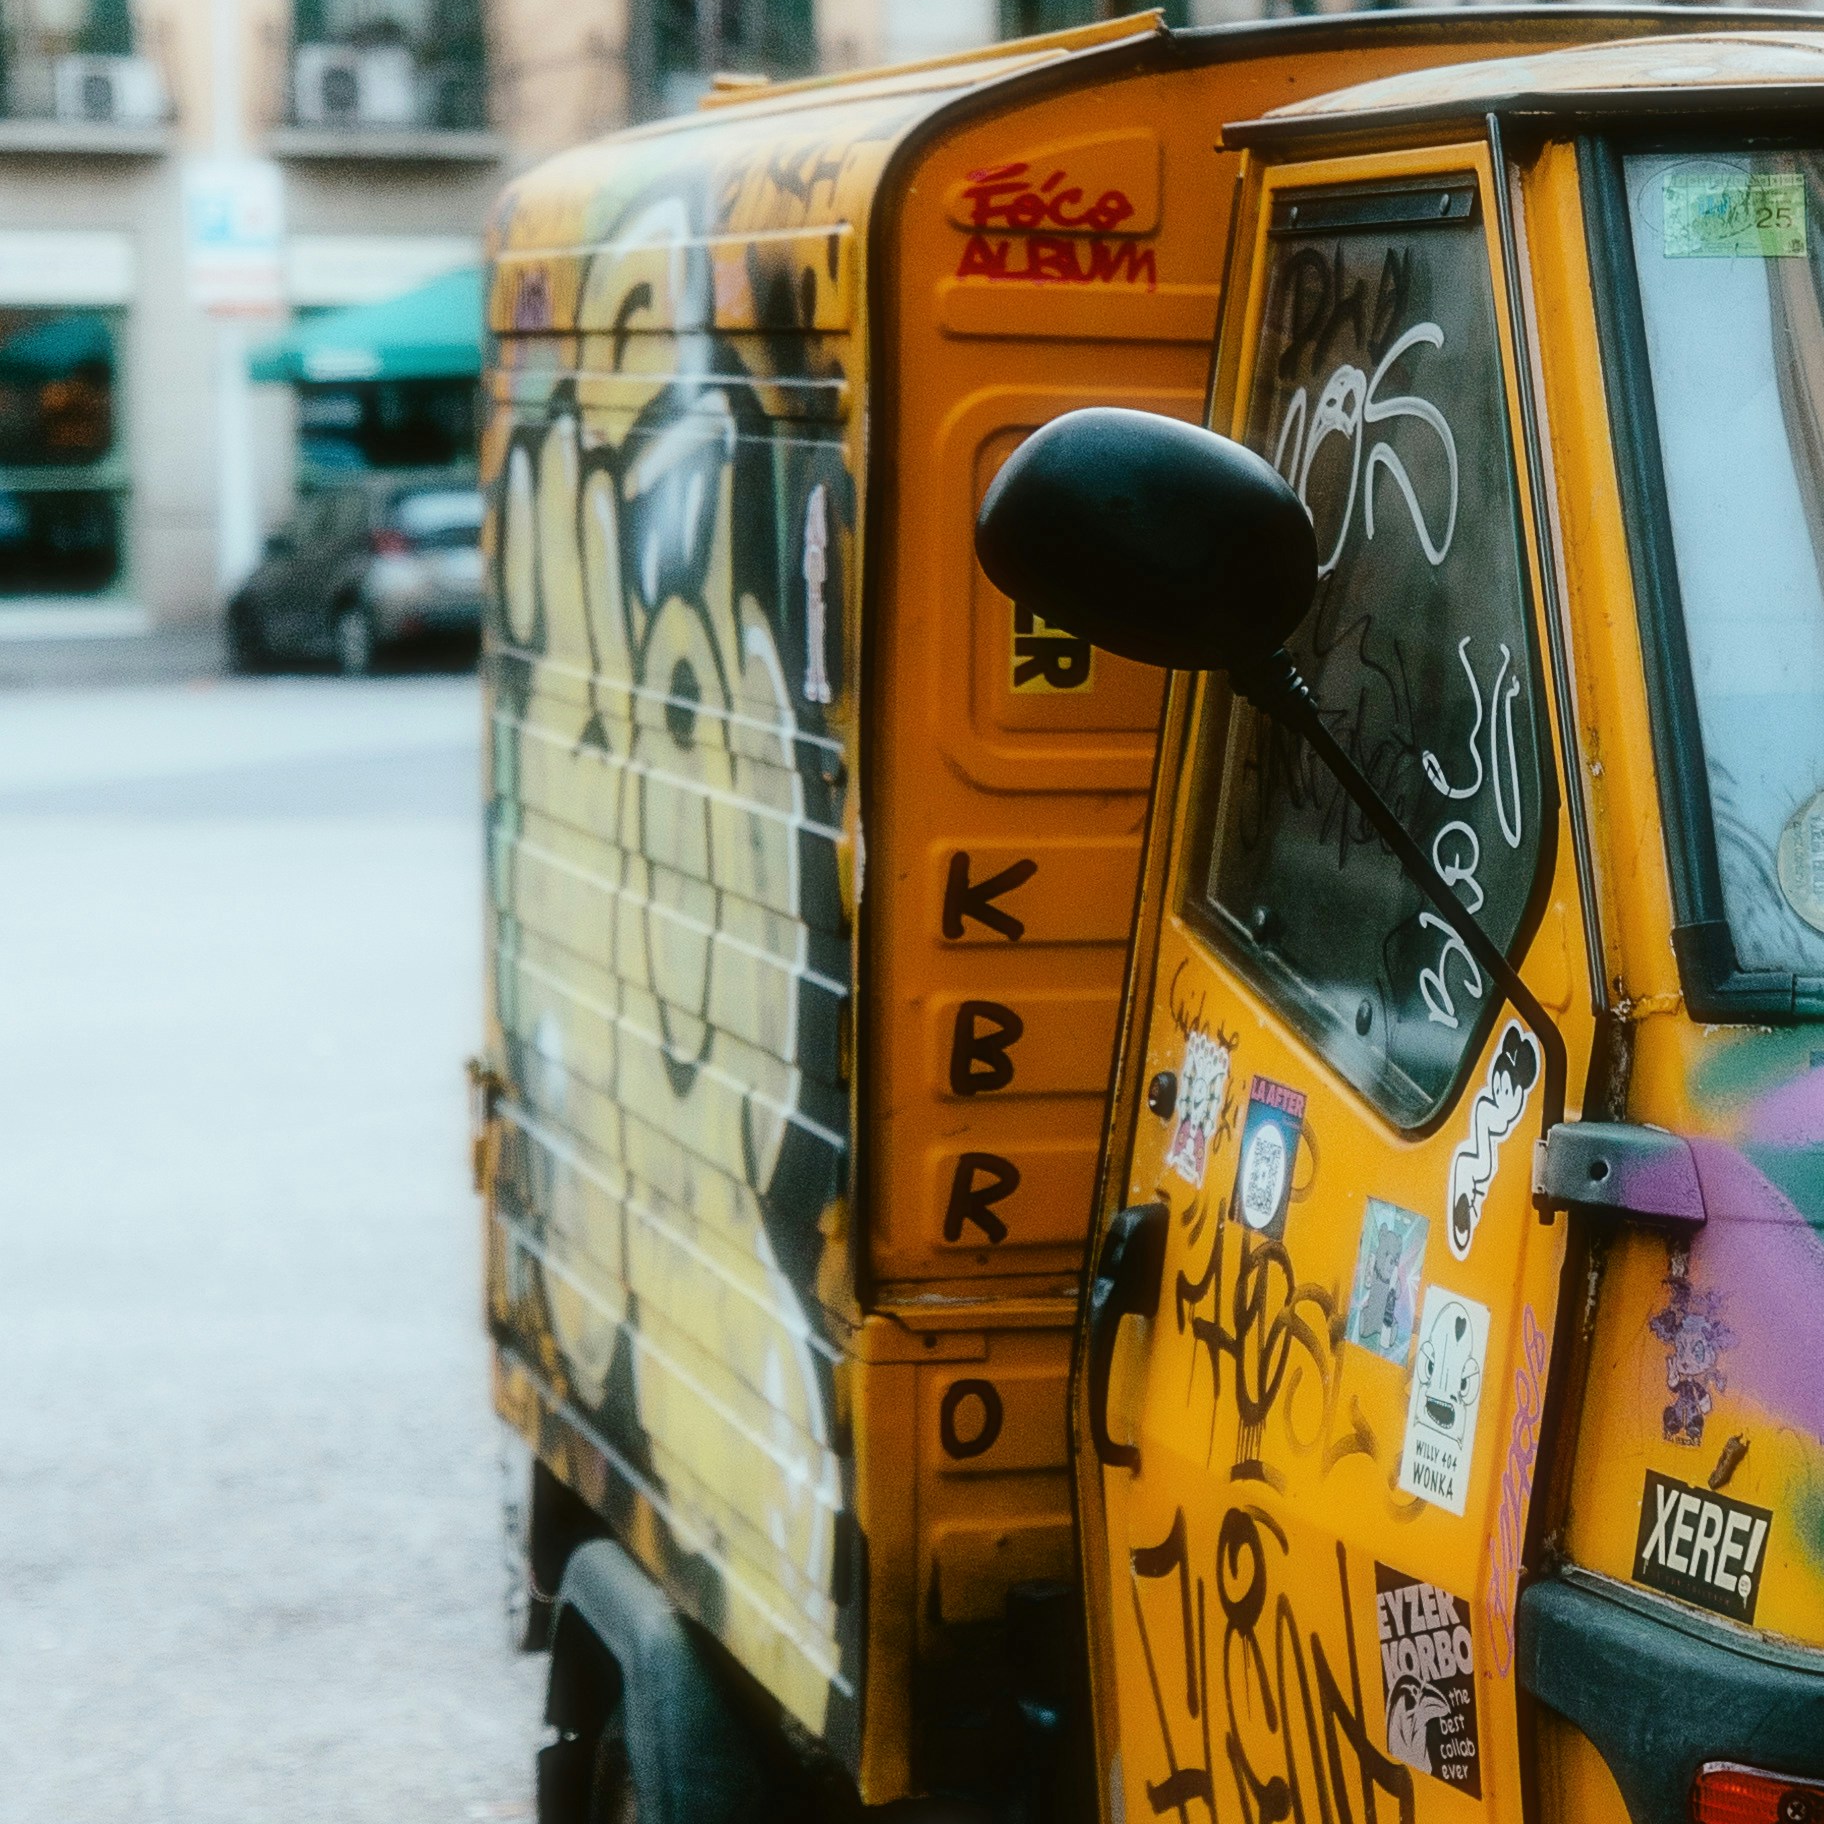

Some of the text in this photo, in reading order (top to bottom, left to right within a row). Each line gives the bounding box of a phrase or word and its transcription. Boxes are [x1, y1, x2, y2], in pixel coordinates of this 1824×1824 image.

[1755, 207, 1793, 229] 25
[1415, 1439, 1458, 1472] WILLY 404
[1412, 1461, 1454, 1501] WONKA
[1641, 1483, 1769, 1599] XERE!
[1380, 1625, 1474, 1689] KORBO
[1448, 1687, 1472, 1707] the
[1439, 1713, 1466, 1736] best
[1440, 1738, 1476, 1758] collab
[1441, 1765, 1469, 1781] ever
